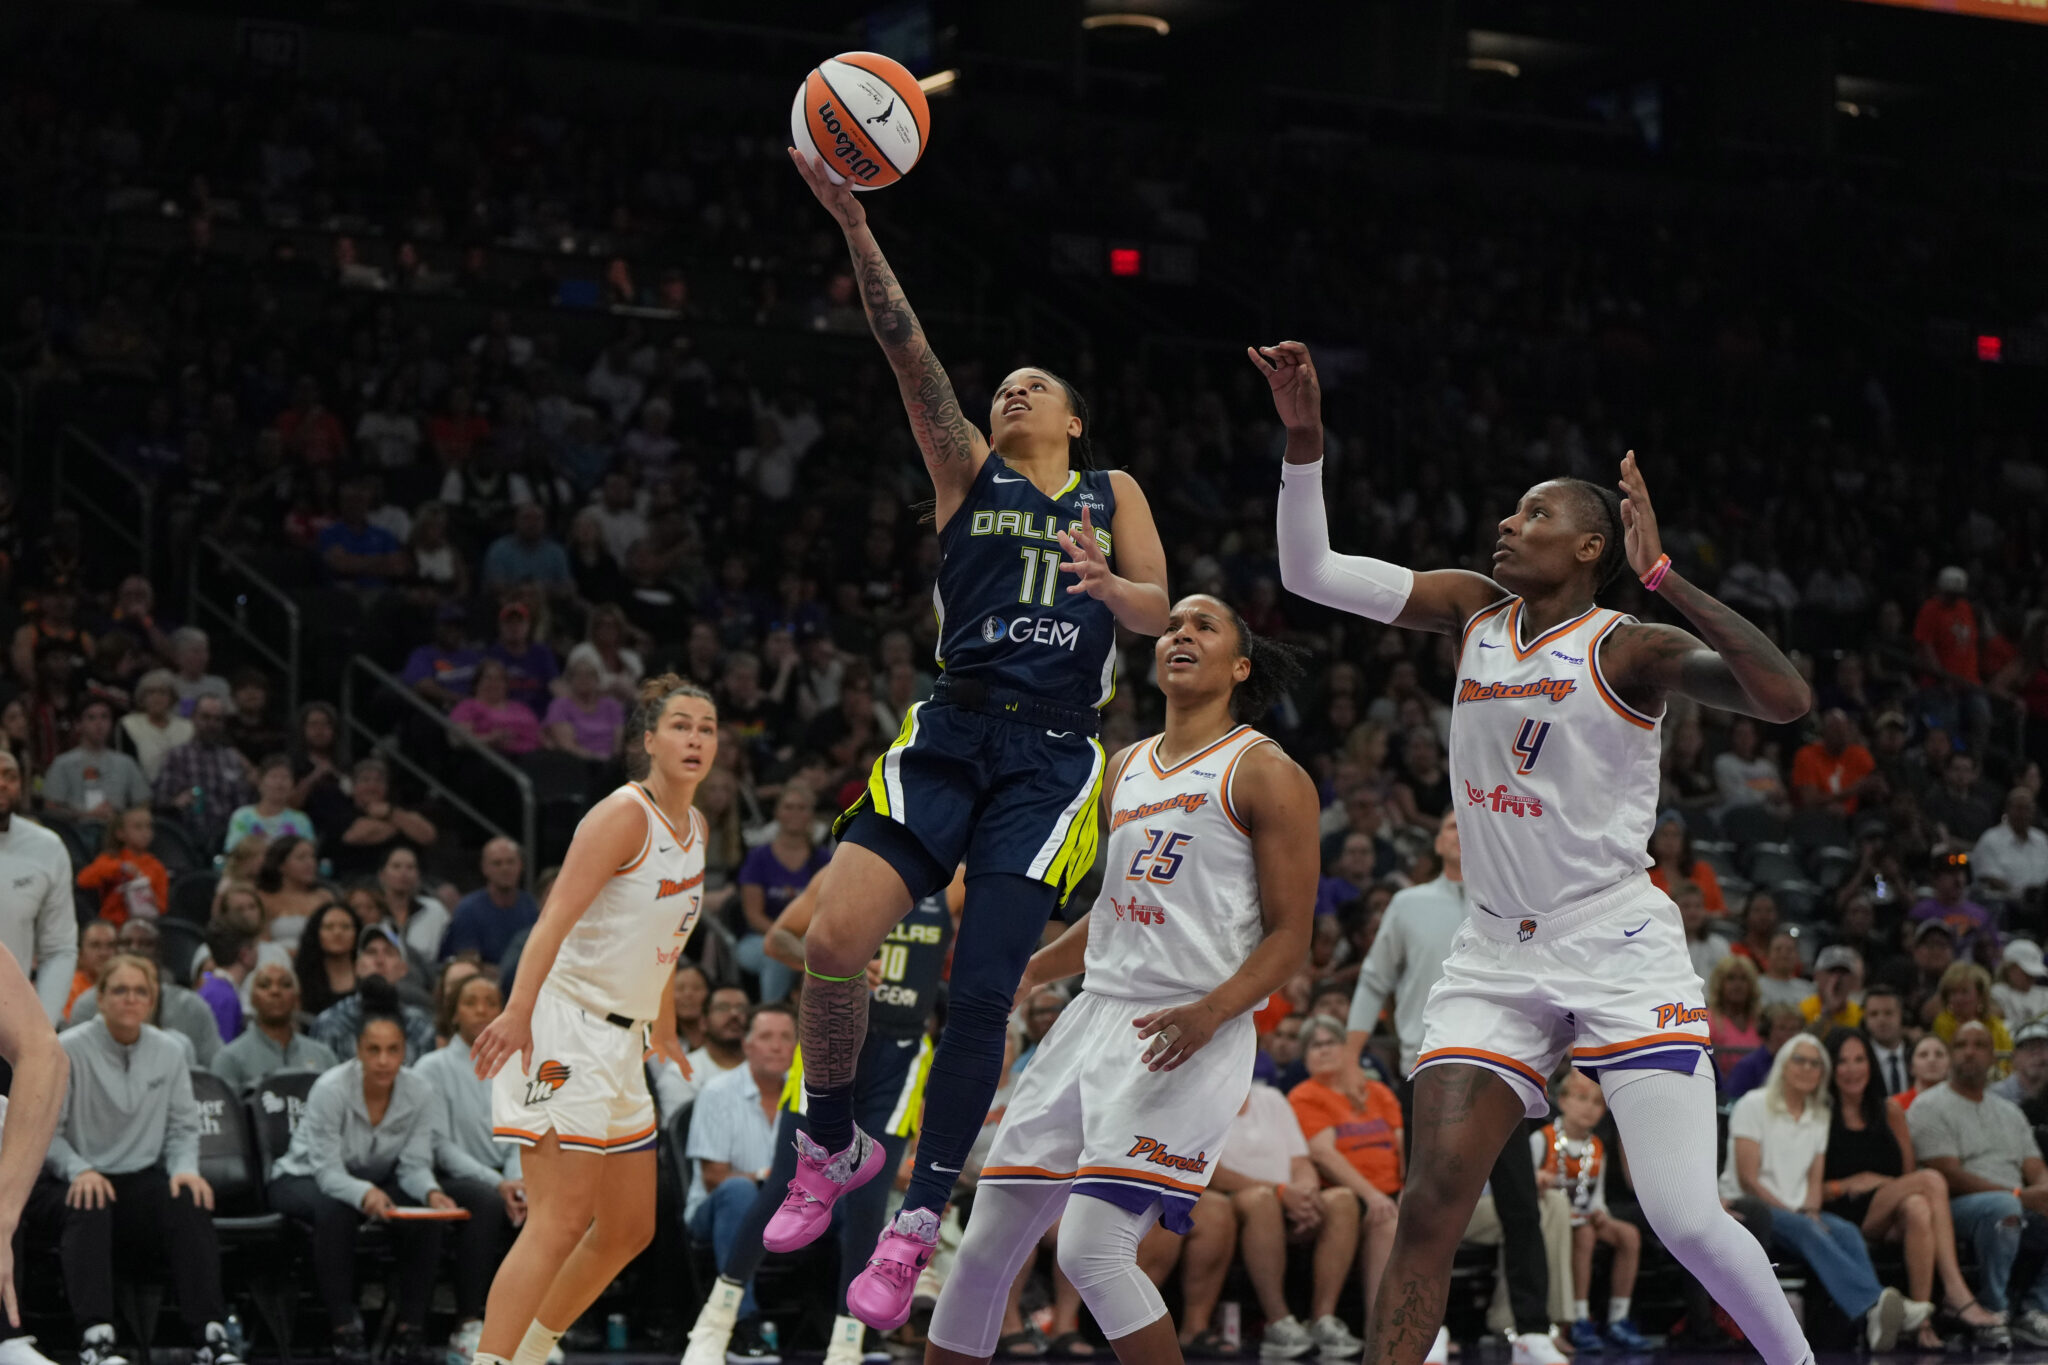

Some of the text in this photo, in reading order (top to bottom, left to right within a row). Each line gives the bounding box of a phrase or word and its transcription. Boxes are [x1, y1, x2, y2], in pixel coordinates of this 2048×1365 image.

[818, 100, 881, 182] Wilson
[1018, 546, 1062, 606] 11
[1008, 616, 1081, 651] GEM
[1457, 677, 1578, 706] Mercury
[1512, 716, 1552, 775] 4
[1111, 792, 1209, 834] Mercury
[1487, 784, 1543, 818] fry's
[1126, 826, 1194, 885] 25
[879, 942, 909, 982] 10
[1125, 1135, 1209, 1174] Phoenix
